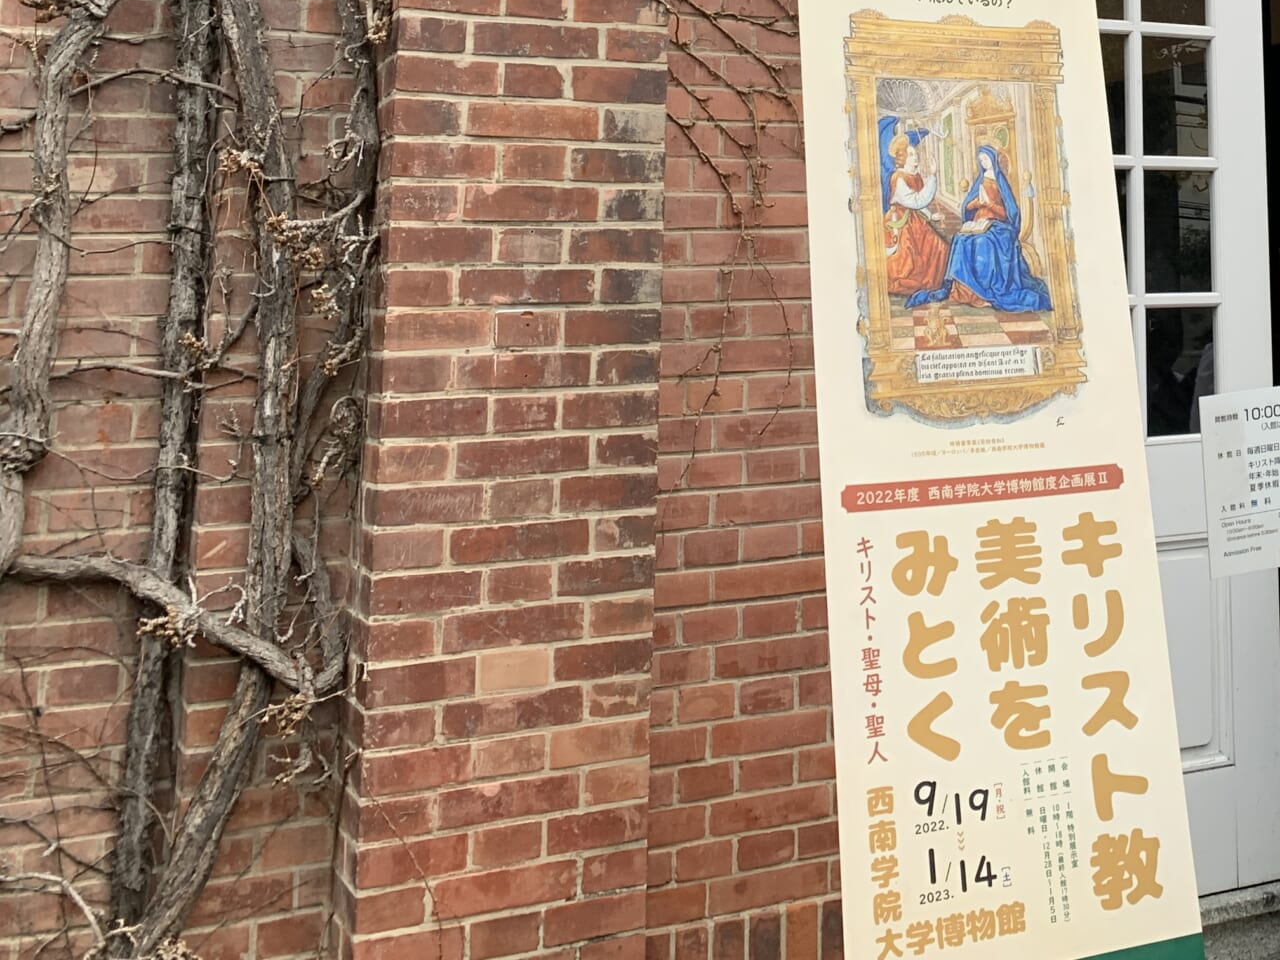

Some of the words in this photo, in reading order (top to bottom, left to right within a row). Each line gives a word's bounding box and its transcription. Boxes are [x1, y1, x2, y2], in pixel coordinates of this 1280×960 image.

[857, 487, 920, 505] 2022年度
[1247, 442, 1280, 456] 毎週日曜日
[856, 536, 889, 766] キリスト・聖母・聖人
[891, 529, 961, 762] みとく
[974, 516, 1051, 750] 美術を
[1061, 511, 1164, 911] キリスト教
[914, 820, 950, 835] 2022.
[919, 889, 955, 905] 2023.
